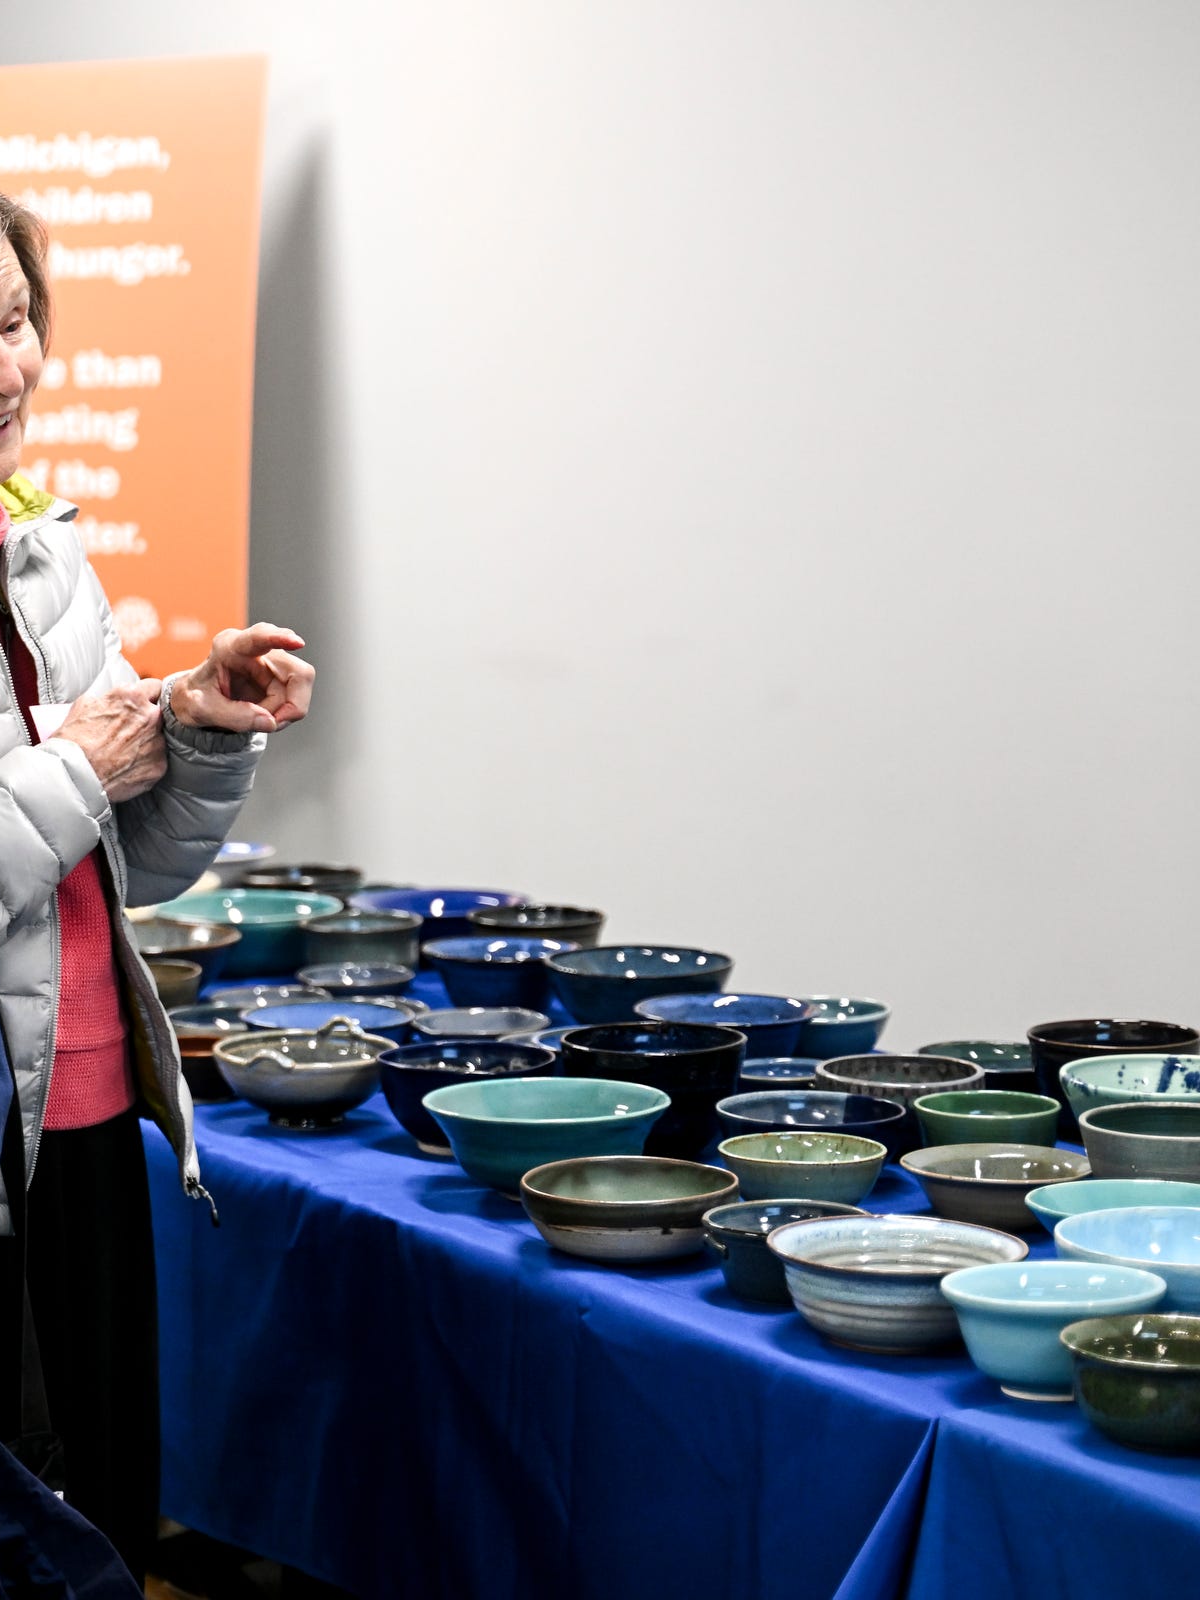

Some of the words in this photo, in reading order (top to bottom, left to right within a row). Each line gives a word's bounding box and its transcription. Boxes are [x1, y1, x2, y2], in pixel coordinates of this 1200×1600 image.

[7, 186, 153, 225] hildren
[49, 241, 191, 286] hunger.
[72, 348, 162, 388] than
[54, 458, 121, 499] the
[77, 515, 148, 555] ter.
